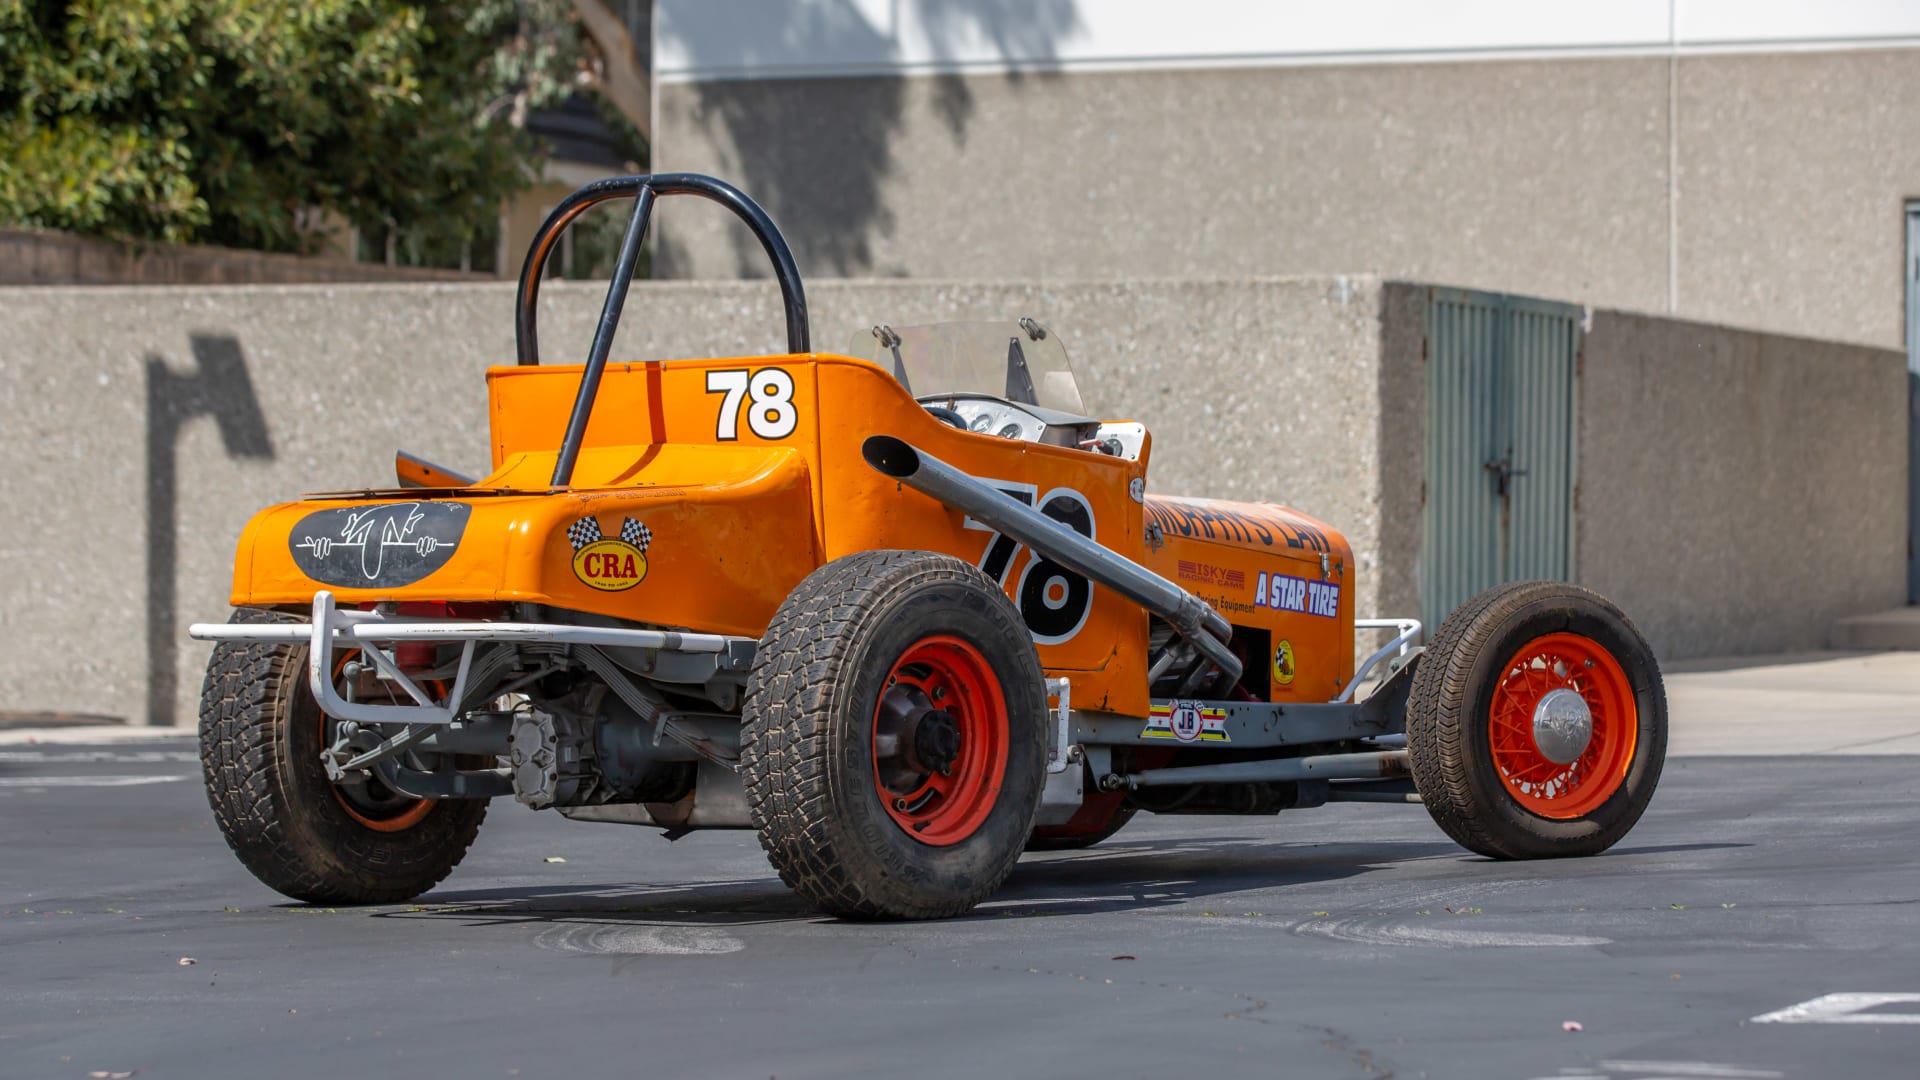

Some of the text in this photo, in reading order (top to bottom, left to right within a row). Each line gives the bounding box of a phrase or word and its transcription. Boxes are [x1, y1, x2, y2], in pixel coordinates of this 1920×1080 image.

[706, 367, 798, 441] 78
[584, 553, 638, 578] CRA
[1197, 563, 1228, 580] ISKY
[1178, 571, 1245, 591] RACING CAMS
[1220, 595, 1256, 615] Equipment
[1255, 571, 1339, 617] A STAR TIRE
